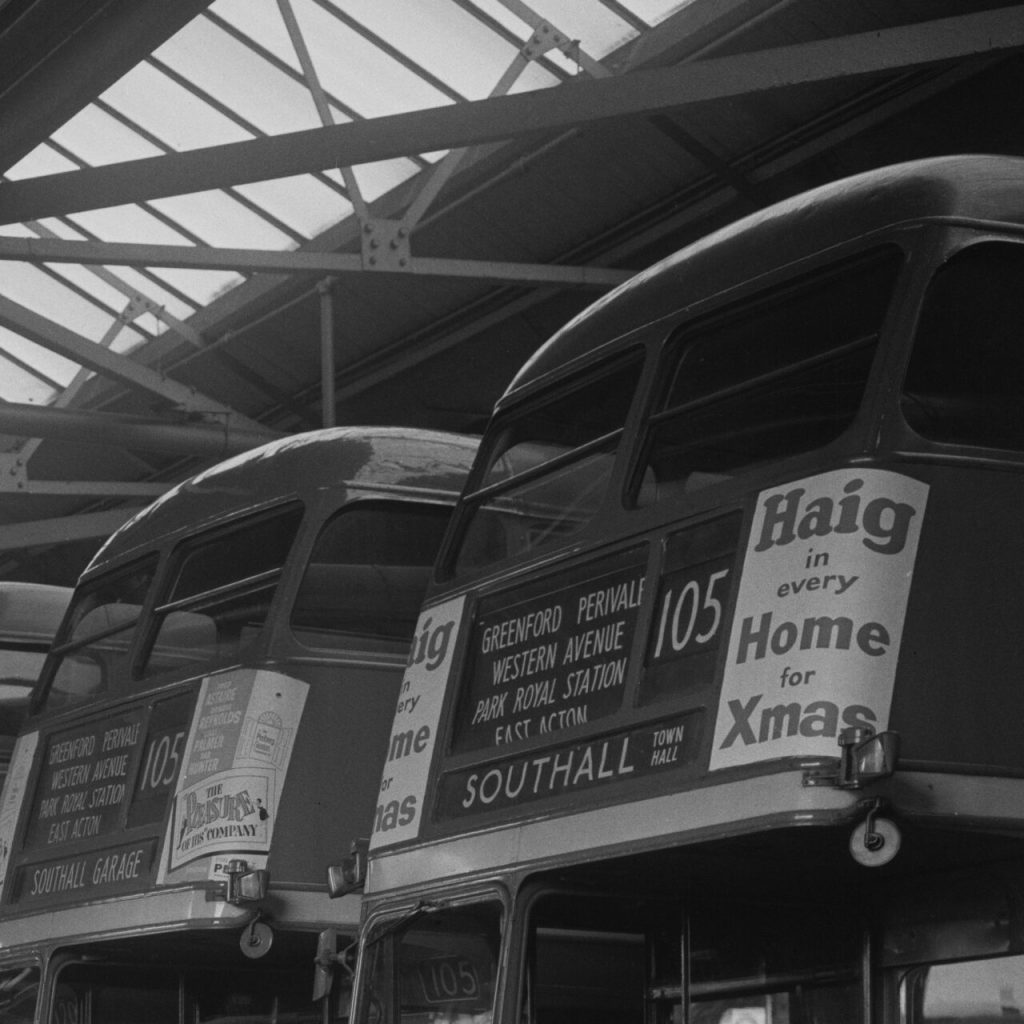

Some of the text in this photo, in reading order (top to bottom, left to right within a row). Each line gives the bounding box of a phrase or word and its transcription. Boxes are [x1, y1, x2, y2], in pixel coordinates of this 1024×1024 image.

[754, 479, 916, 554] Haig
[804, 548, 830, 569] in
[776, 573, 859, 598] every
[482, 605, 563, 654] GREENFORD
[654, 568, 729, 659] 105
[492, 620, 626, 686] WESTERN AVENUE
[735, 610, 891, 664] Home
[472, 657, 627, 725] PARK ROYAL STATION
[780, 667, 816, 689] for
[397, 694, 422, 714] ery
[653, 725, 684, 748] TOWN
[719, 698, 878, 749] Xmas
[48, 735, 96, 766] GREENFORD
[141, 732, 185, 791] 105
[388, 724, 431, 763] me
[650, 745, 678, 767] HALL
[51, 754, 129, 791] WESTERN AVENUE
[206, 783, 224, 799] THE
[381, 776, 394, 793] or
[462, 737, 634, 808] SOUTHALL
[38, 783, 126, 820] PARK ROYAL STATION
[47, 814, 103, 844] EAST ACTON
[31, 860, 87, 896] SOUTHALL
[92, 850, 144, 885] GARAGE
[432, 961, 476, 997] 105
